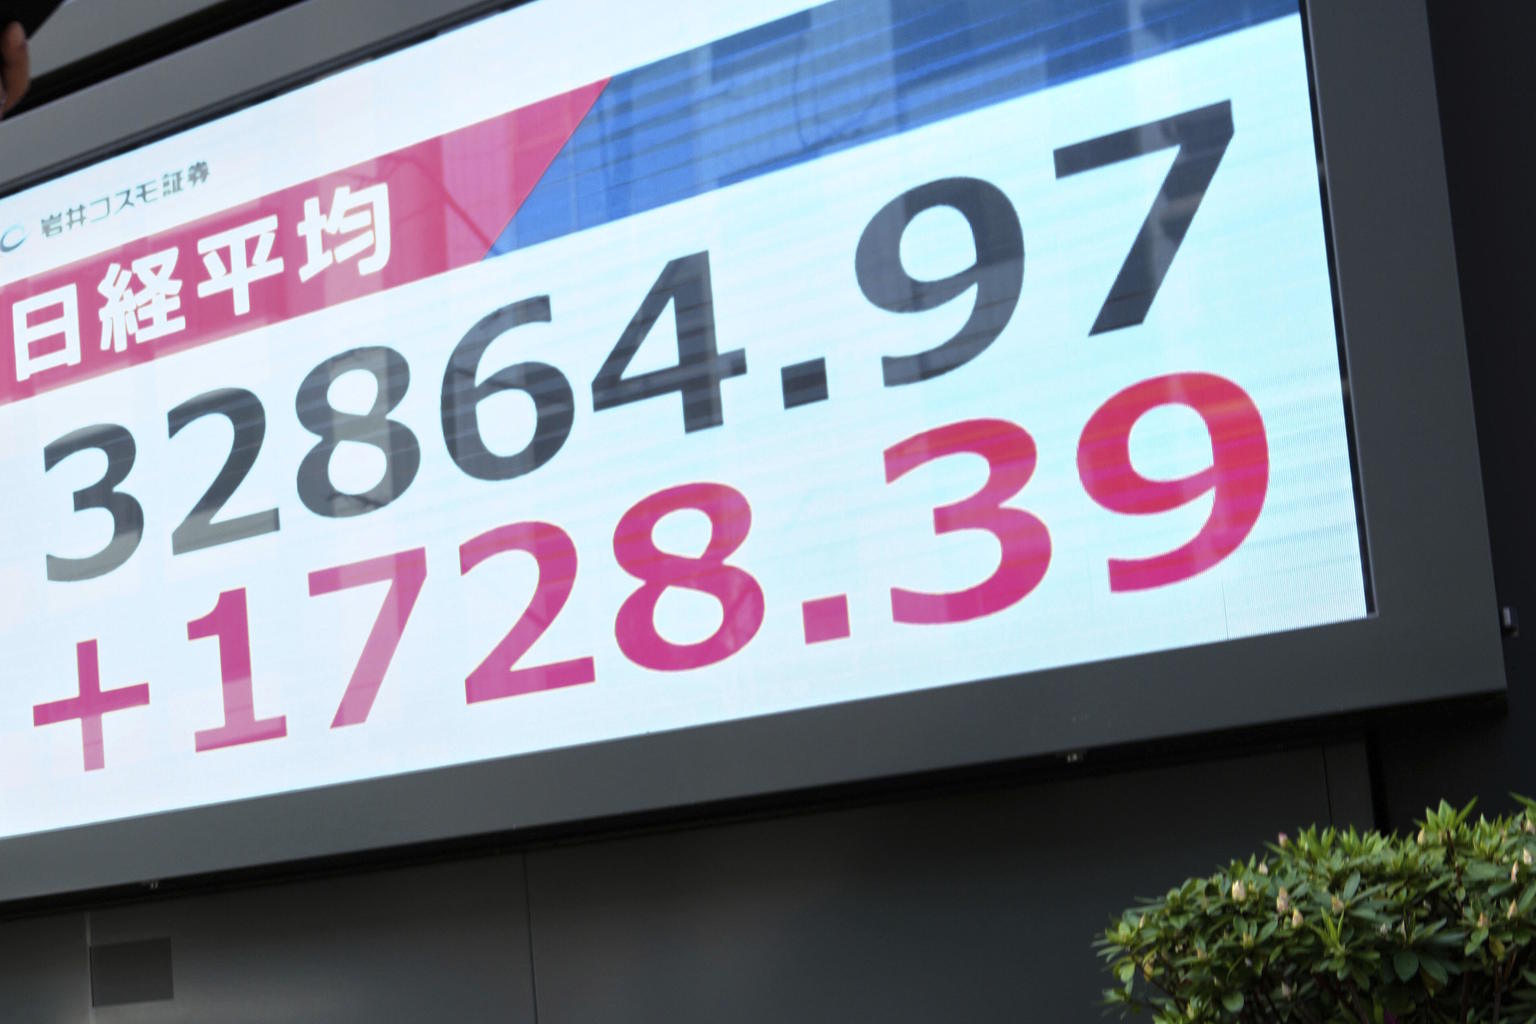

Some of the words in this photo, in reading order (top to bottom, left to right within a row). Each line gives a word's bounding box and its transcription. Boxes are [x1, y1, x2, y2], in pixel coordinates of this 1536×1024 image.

[12, 182, 391, 382] 日経平均
[41, 160, 210, 238] 岩井コスモ証券
[44, 100, 1234, 581] 32864.97
[33, 371, 1269, 771] +1728.39
